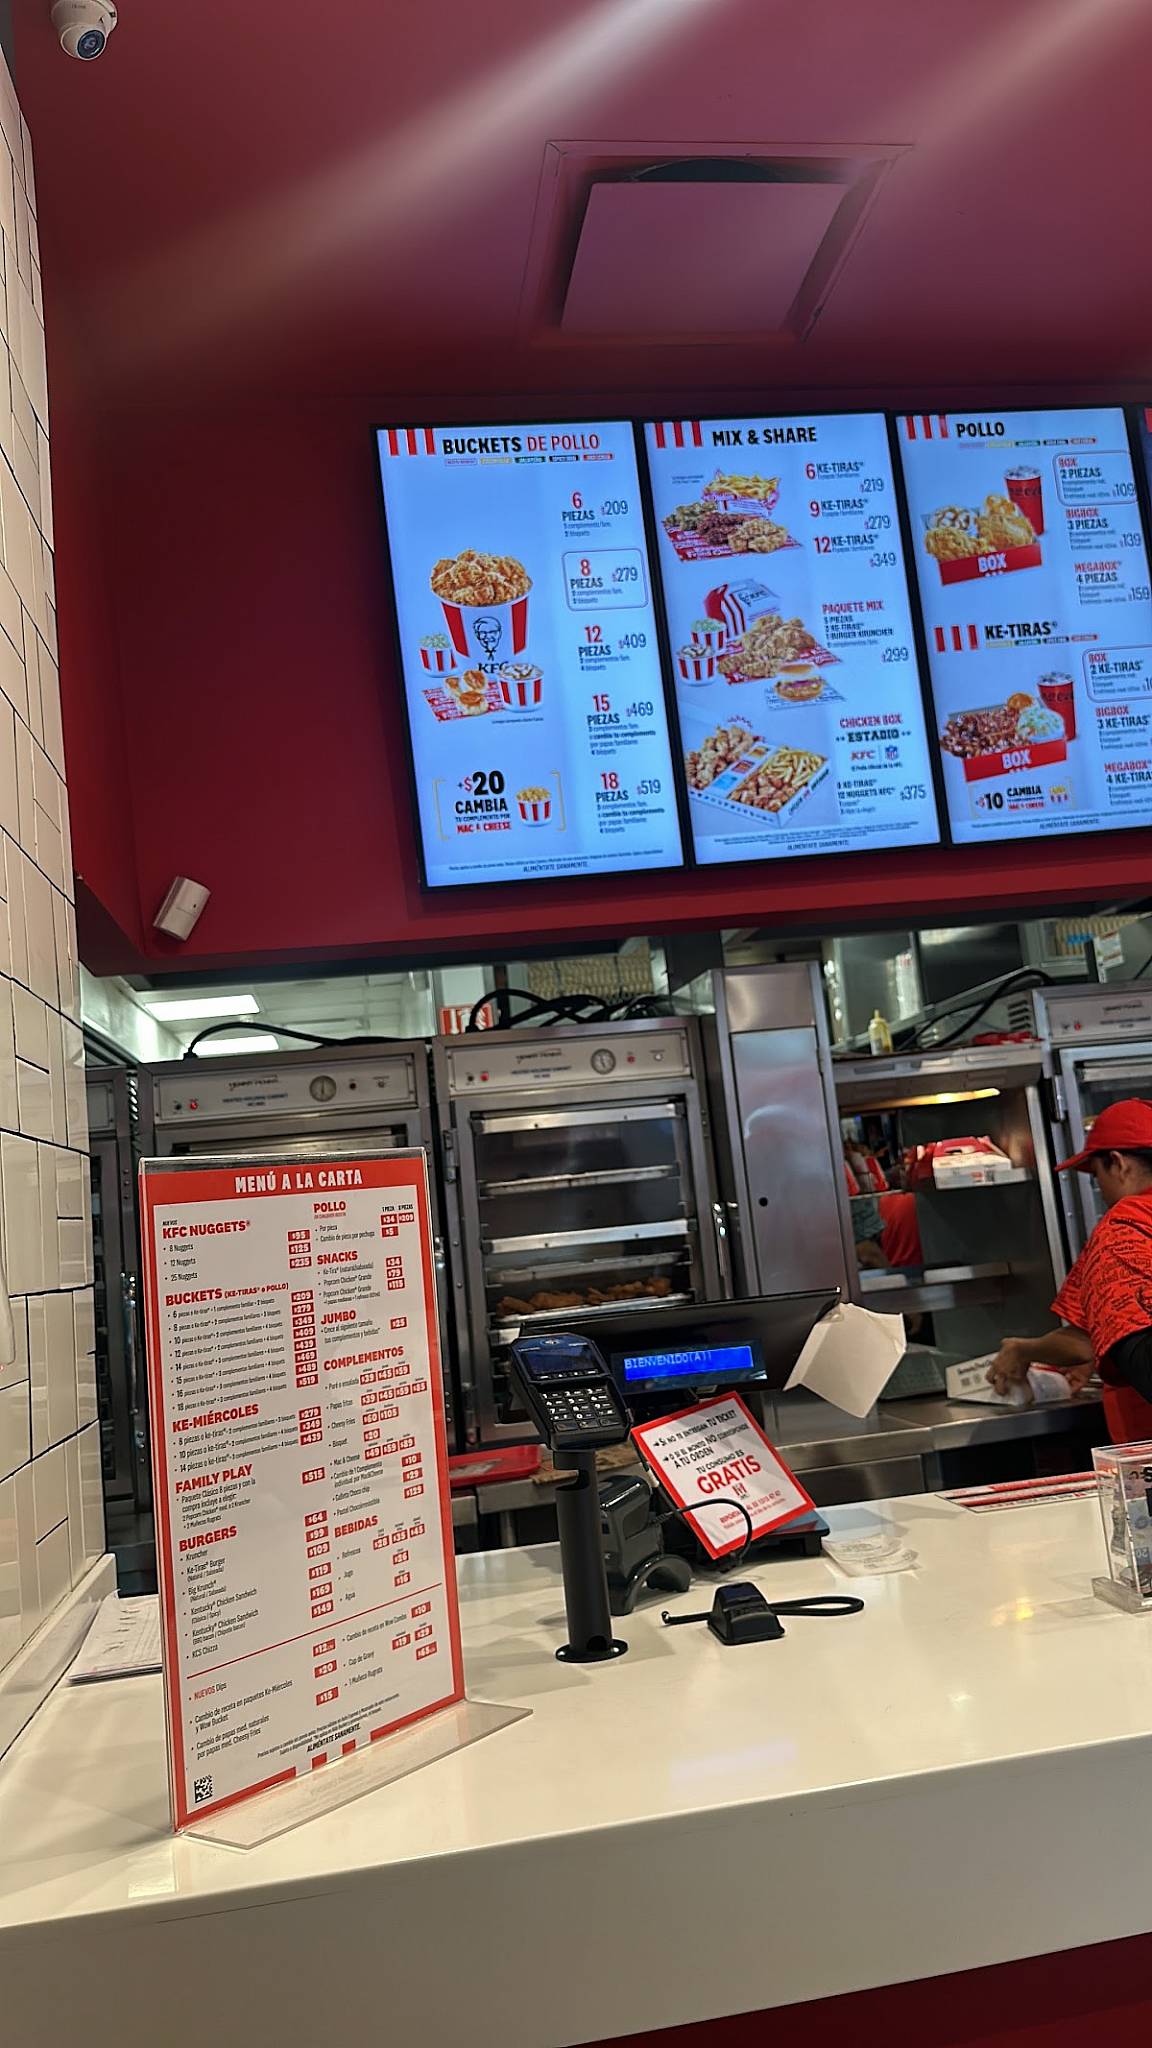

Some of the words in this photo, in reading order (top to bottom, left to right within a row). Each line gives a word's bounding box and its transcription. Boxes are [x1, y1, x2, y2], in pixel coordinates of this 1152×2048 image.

[713, 429, 743, 447] MIX
[747, 428, 758, 444] &
[764, 427, 817, 444] SHARE
[956, 422, 1005, 438] POLLO
[442, 437, 522, 455] BUCKETS
[527, 436, 548, 451] DE
[551, 434, 600, 450] POLLO
[805, 464, 816, 480] 6
[1060, 469, 1067, 479] 2
[1069, 467, 1101, 478] PIEZAS
[860, 479, 884, 493] $219
[572, 491, 582, 509] 6
[562, 510, 595, 522] PIEZAS
[601, 500, 629, 516] $209
[810, 501, 820, 517] 9
[864, 516, 891, 530] $279
[1067, 519, 1074, 530] 3
[1076, 518, 1108, 529] PIEZAS
[815, 537, 831, 554] 12
[1120, 533, 1141, 548] $139
[580, 559, 591, 576] 8
[870, 553, 897, 568] $349
[978, 553, 1007, 572] BOX
[570, 578, 603, 590] PIEZAS
[612, 567, 638, 583] $279
[1076, 574, 1083, 584] 4
[1084, 573, 1118, 584] PIEZAS
[822, 601, 864, 614] PAQUETE
[867, 600, 884, 611] MIX
[584, 625, 602, 643] 12
[578, 645, 612, 657] PIEZAS
[618, 634, 647, 649] $409
[882, 648, 909, 663] $299
[593, 694, 610, 712] 15
[587, 714, 620, 726] PIEZAS
[626, 701, 653, 717] $469
[840, 716, 880, 728] CHICKEN
[882, 714, 902, 726] BOX
[848, 729, 899, 742] ESTADIO
[1002, 749, 1031, 769] BOX
[601, 772, 618, 790] 18
[596, 791, 629, 803] PIEZAS
[637, 779, 661, 796] $519
[901, 784, 926, 800] $375
[1007, 785, 1042, 797] CAMBIA
[455, 798, 508, 814] CAMBIA
[235, 1171, 276, 1193] MENÚ
[282, 1173, 292, 1190] A
[296, 1172, 313, 1189] LA
[318, 1169, 362, 1187] CARTA
[314, 1201, 346, 1213] POLLO
[162, 1226, 188, 1239] KFC
[174, 1243, 194, 1253] Nuggets
[291, 1244, 309, 1254] $125
[176, 1258, 196, 1267] Nuggets
[291, 1257, 310, 1267] $235
[317, 1251, 358, 1265] SNACKS
[178, 1272, 198, 1281] Nuggets
[165, 1288, 222, 1306] BUCKETS
[321, 1310, 356, 1325] JUMBO
[324, 1346, 404, 1371] COMPLEMENTOS
[172, 1404, 259, 1433] KE-MIÉRCOLES
[706, 1418, 717, 1427] TU
[715, 1409, 736, 1423] TICKET
[704, 1434, 717, 1445] NO
[673, 1460, 681, 1469] A
[680, 1456, 690, 1466] TU
[690, 1446, 715, 1462] ORDEN
[696, 1466, 705, 1474] TU
[706, 1453, 735, 1470] CONSUMO
[734, 1449, 745, 1458] ES
[175, 1470, 220, 1494] FAMILY
[223, 1463, 253, 1483] PLAY
[697, 1454, 761, 1494] GRATIS
[334, 1515, 378, 1538] BEBIDAS
[179, 1525, 238, 1552] BURGERS
[194, 1686, 215, 1700] NUEVOS
[216, 1683, 227, 1692] Dips
[195, 1711, 213, 1723] Cambio
[197, 1737, 214, 1750] Cambio
